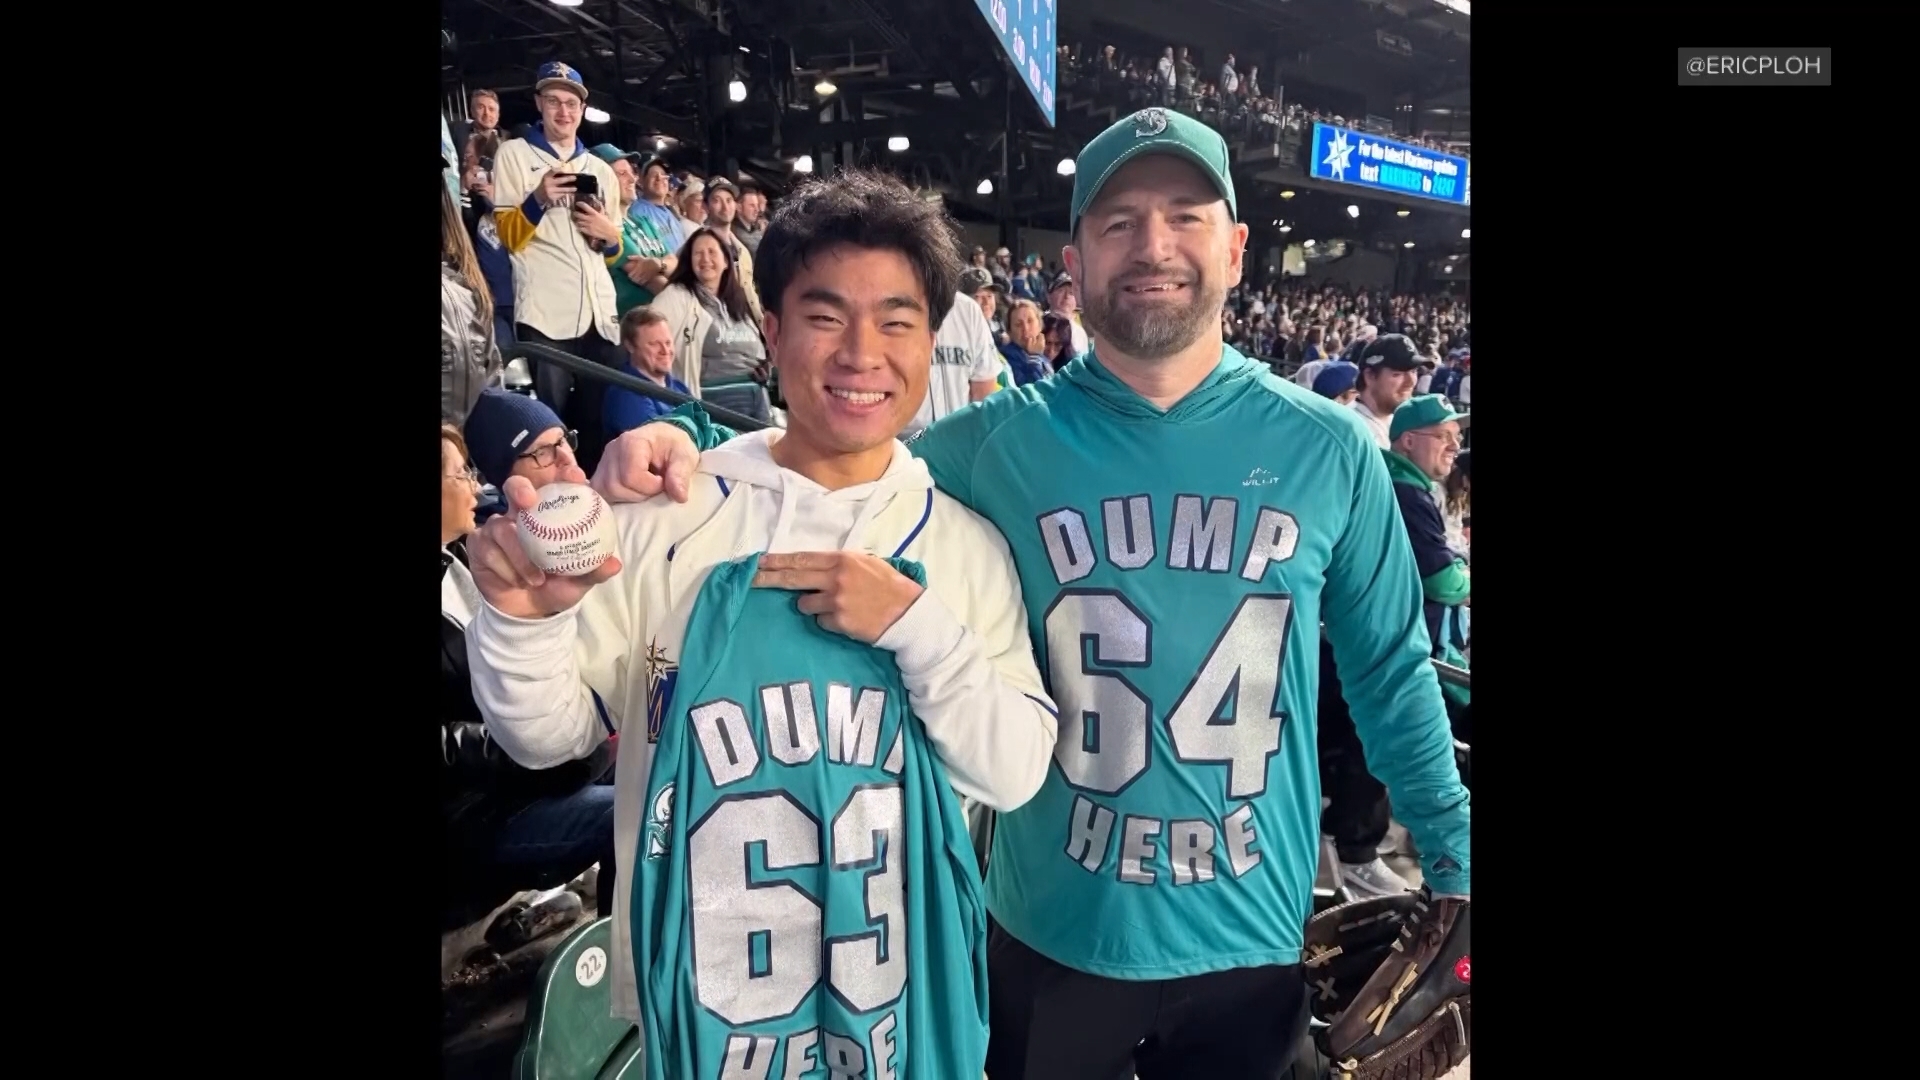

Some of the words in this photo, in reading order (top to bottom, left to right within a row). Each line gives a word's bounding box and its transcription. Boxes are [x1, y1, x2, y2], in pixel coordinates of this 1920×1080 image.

[1359, 139, 1371, 157] For
[1371, 143, 1384, 160] the
[1405, 150, 1433, 171] Mariners
[1361, 162, 1379, 182] text
[1423, 175, 1432, 193] to
[1036, 493, 1300, 585] DUMP
[688, 681, 905, 789] DUM
[1044, 587, 1293, 800] 64
[1064, 793, 1263, 886] HERE
[687, 783, 908, 1027] 63
[581, 953, 602, 980] 22
